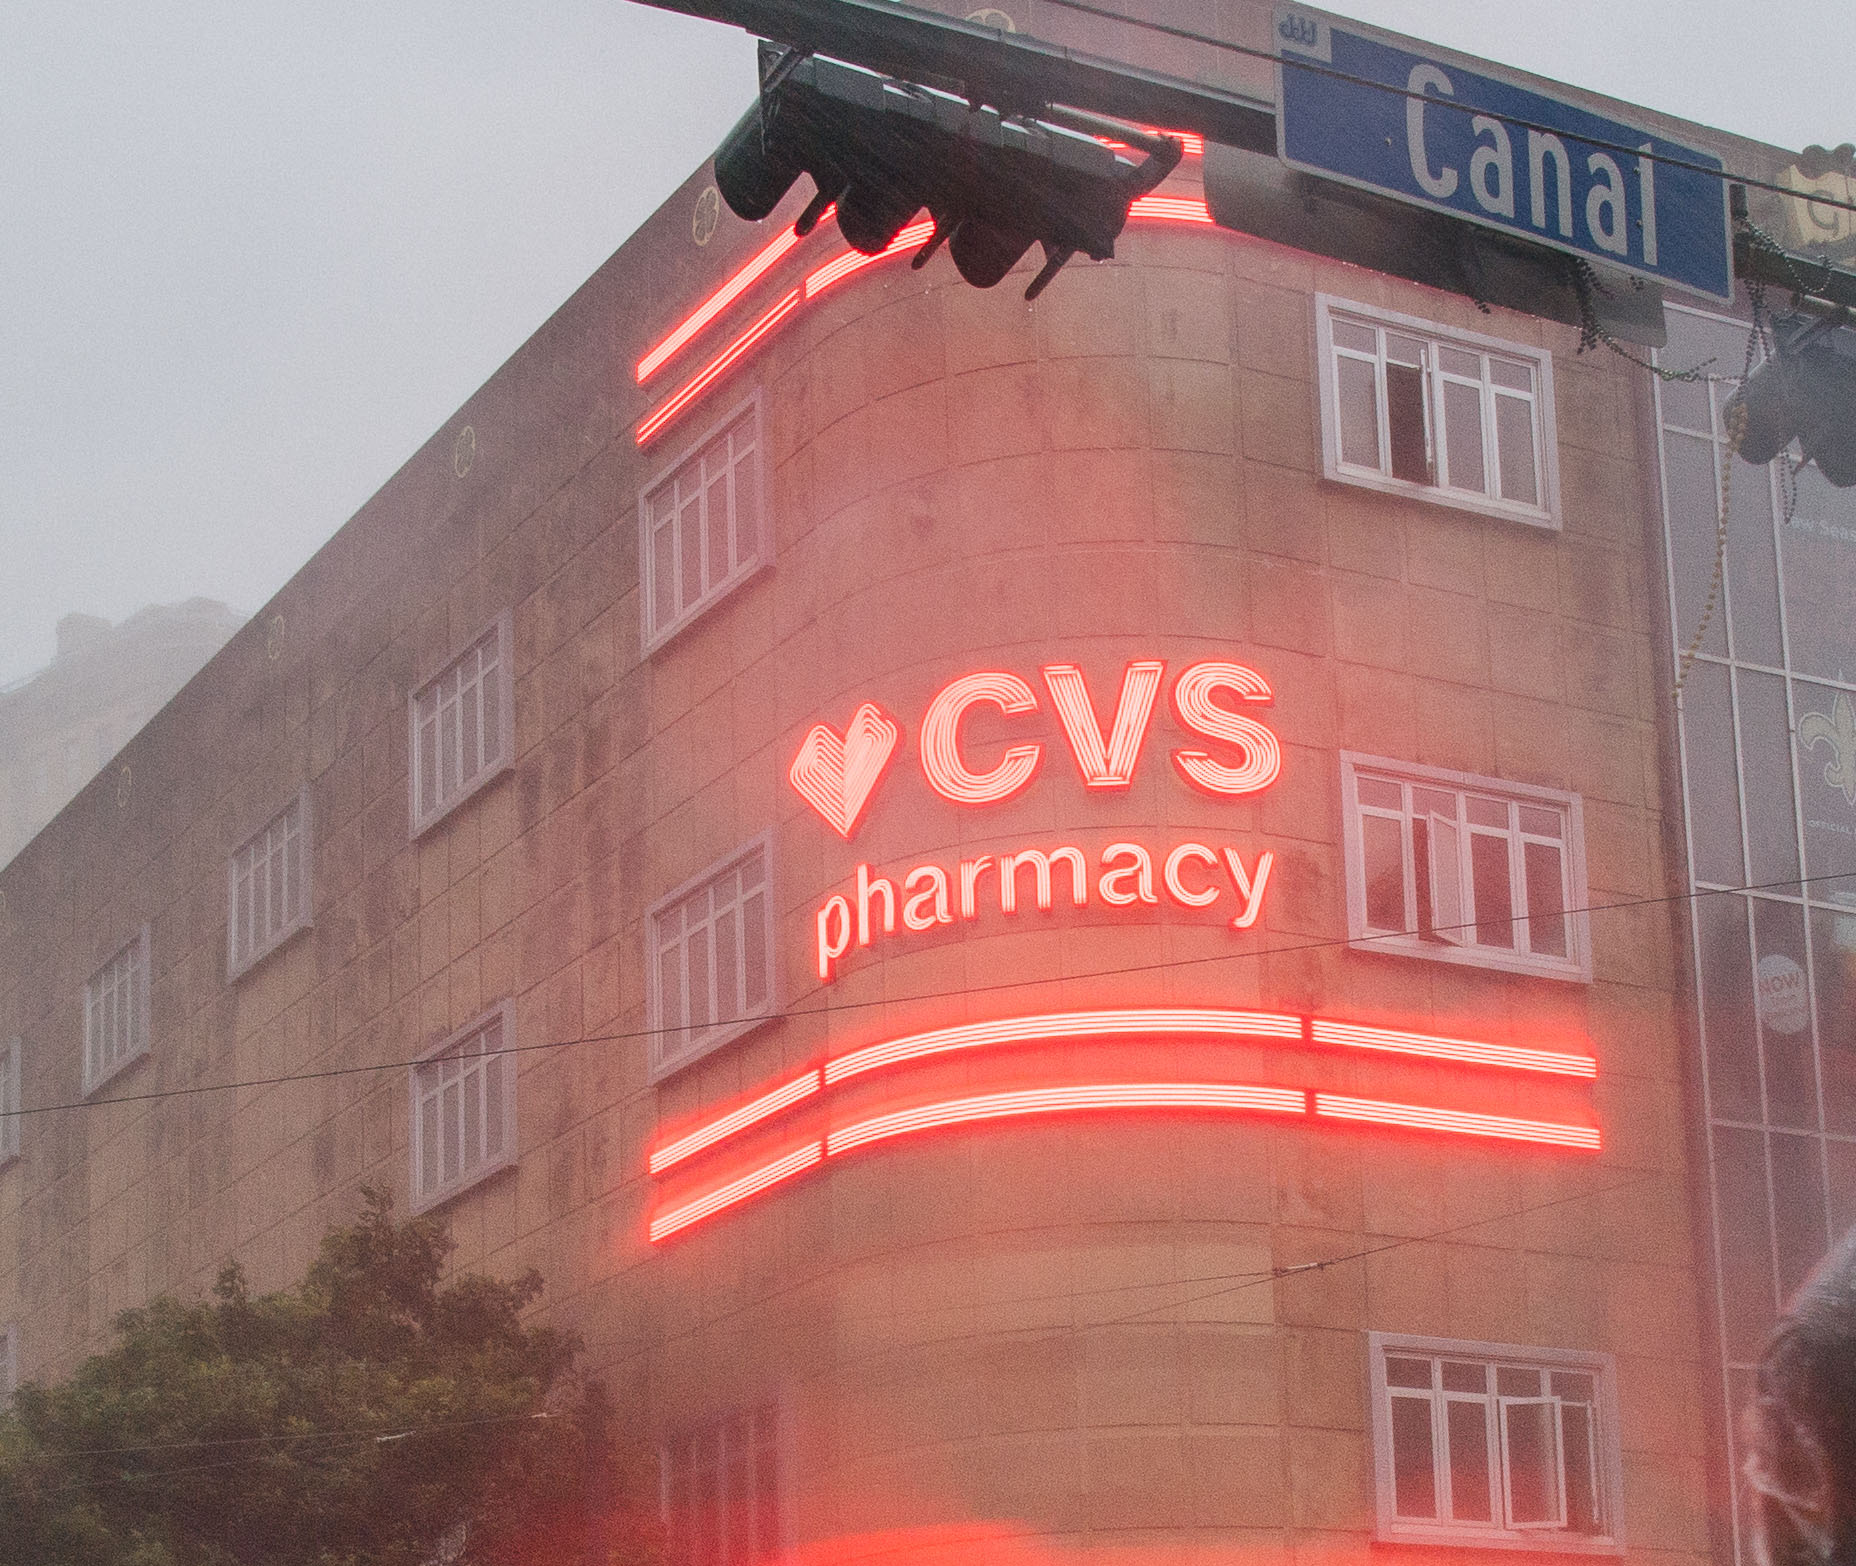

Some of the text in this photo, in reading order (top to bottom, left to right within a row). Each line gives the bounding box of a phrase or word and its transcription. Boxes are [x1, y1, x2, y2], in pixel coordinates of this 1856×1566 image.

[1406, 63, 1659, 267] Canal
[921, 661, 1282, 803] CVS
[1808, 819, 1852, 835] OFFICIAL
[817, 843, 1274, 979] pharmacy
[1759, 971, 1800, 994] NOW
